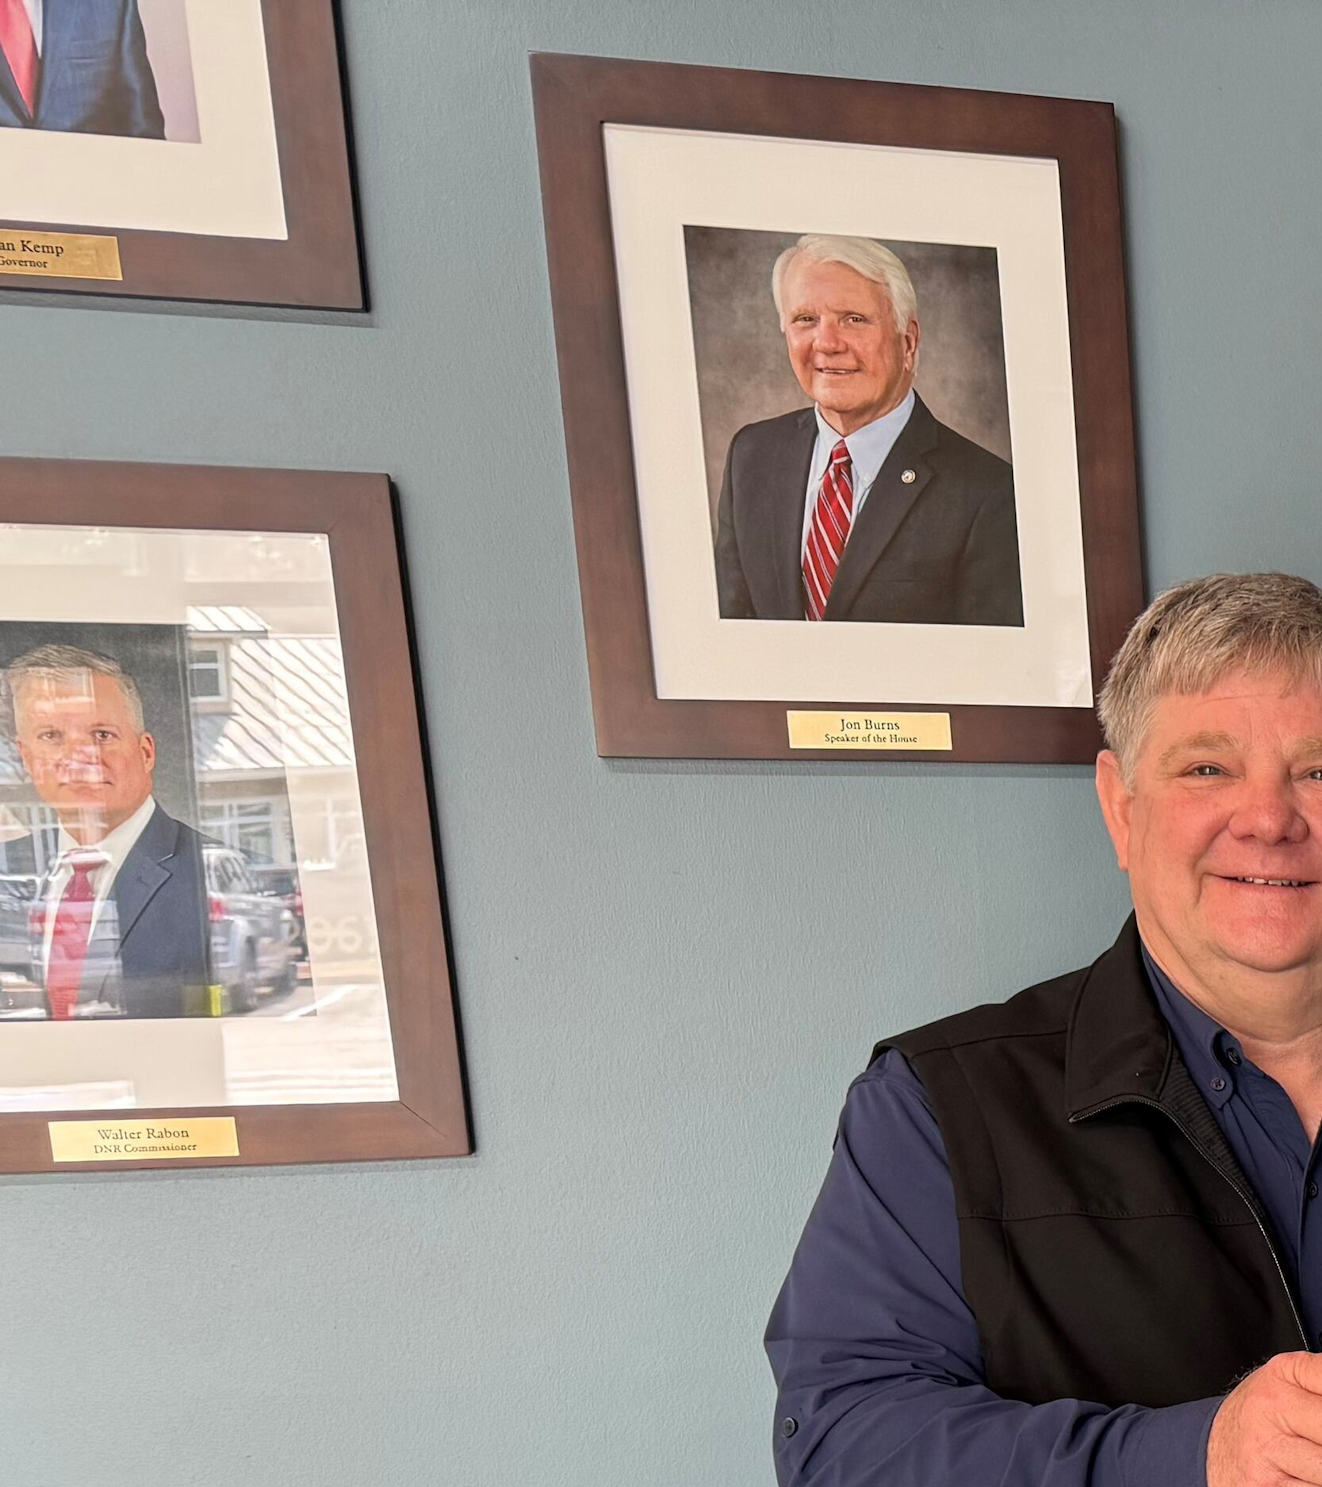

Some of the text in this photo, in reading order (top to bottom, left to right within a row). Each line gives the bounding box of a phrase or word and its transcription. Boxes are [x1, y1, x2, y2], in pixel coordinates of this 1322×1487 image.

[20, 239, 64, 257] Kemp
[840, 719, 900, 732] Jon Burns
[824, 733, 918, 744] Speaker of the House
[97, 1127, 190, 1140] Walter Rabon
[93, 1143, 197, 1154] DNR Commissioner
